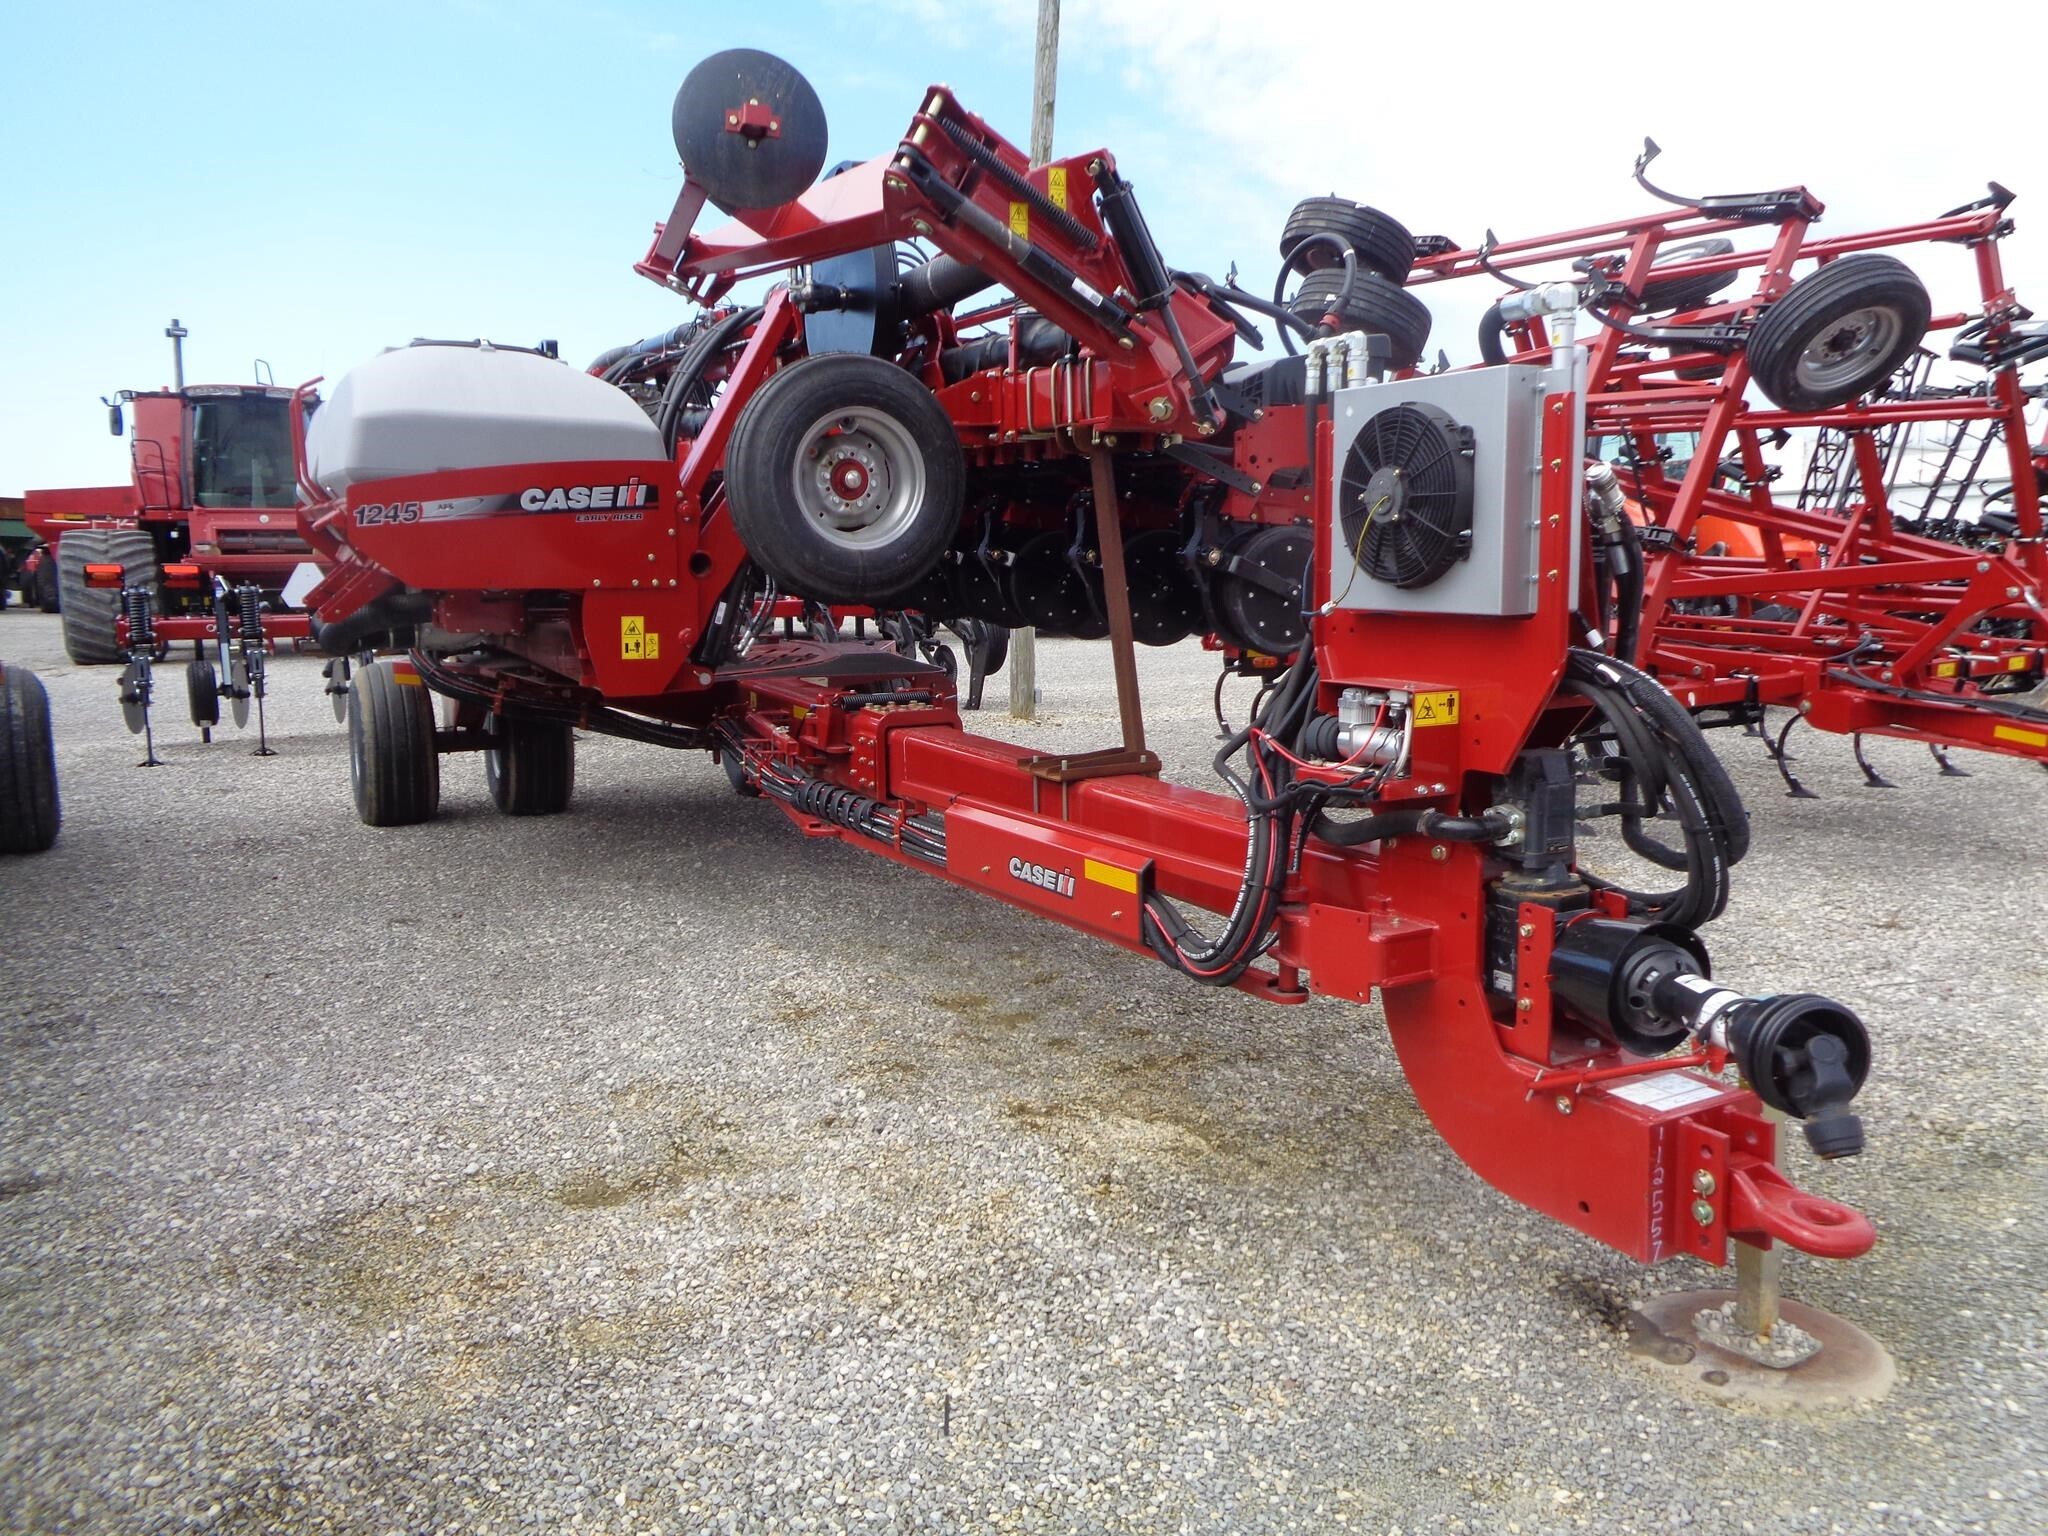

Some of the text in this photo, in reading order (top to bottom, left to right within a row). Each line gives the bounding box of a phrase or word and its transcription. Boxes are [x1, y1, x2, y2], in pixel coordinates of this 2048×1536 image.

[520, 486, 614, 511] CASE
[354, 502, 419, 526] 1245
[576, 512, 643, 522] EARLY RISER
[1009, 857, 1056, 890] CASE
